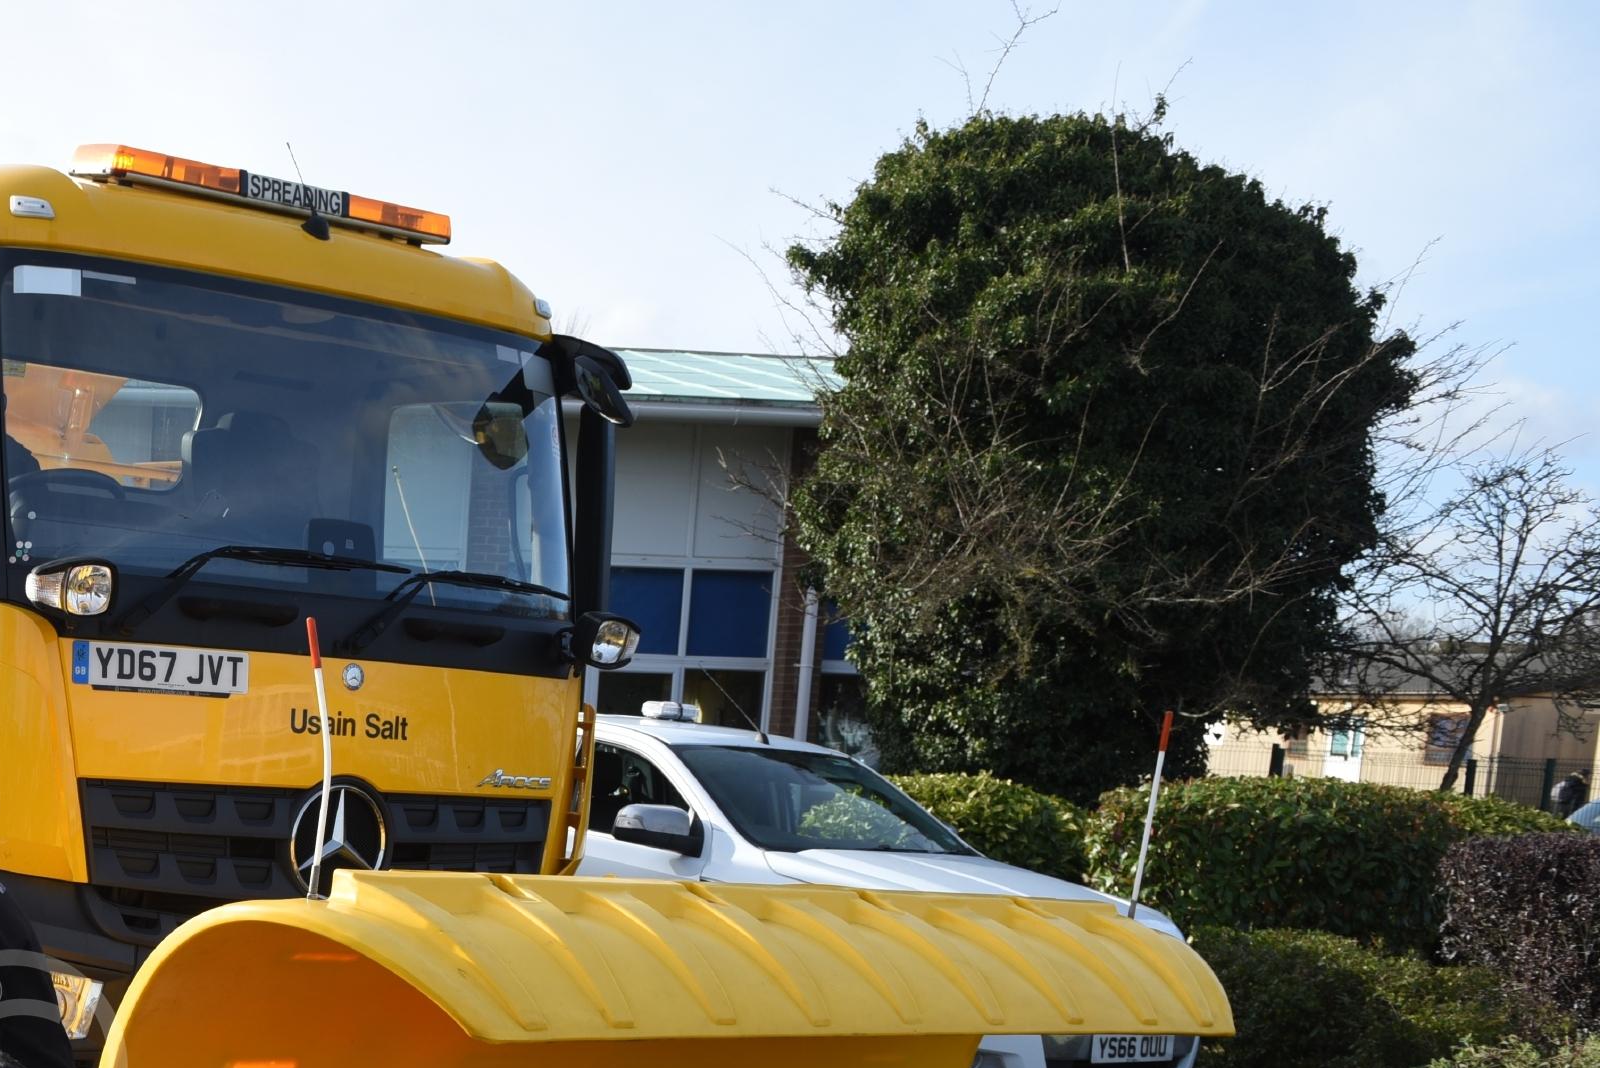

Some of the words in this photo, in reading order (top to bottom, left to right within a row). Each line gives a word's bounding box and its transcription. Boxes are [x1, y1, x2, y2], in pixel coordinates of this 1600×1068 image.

[250, 174, 341, 214] SPREADING
[74, 666, 87, 675] GB
[96, 647, 177, 683] YD67
[186, 653, 243, 687] JVT
[290, 708, 356, 737] Usain
[365, 712, 408, 741] Salt
[1099, 1036, 1137, 1059] YS66
